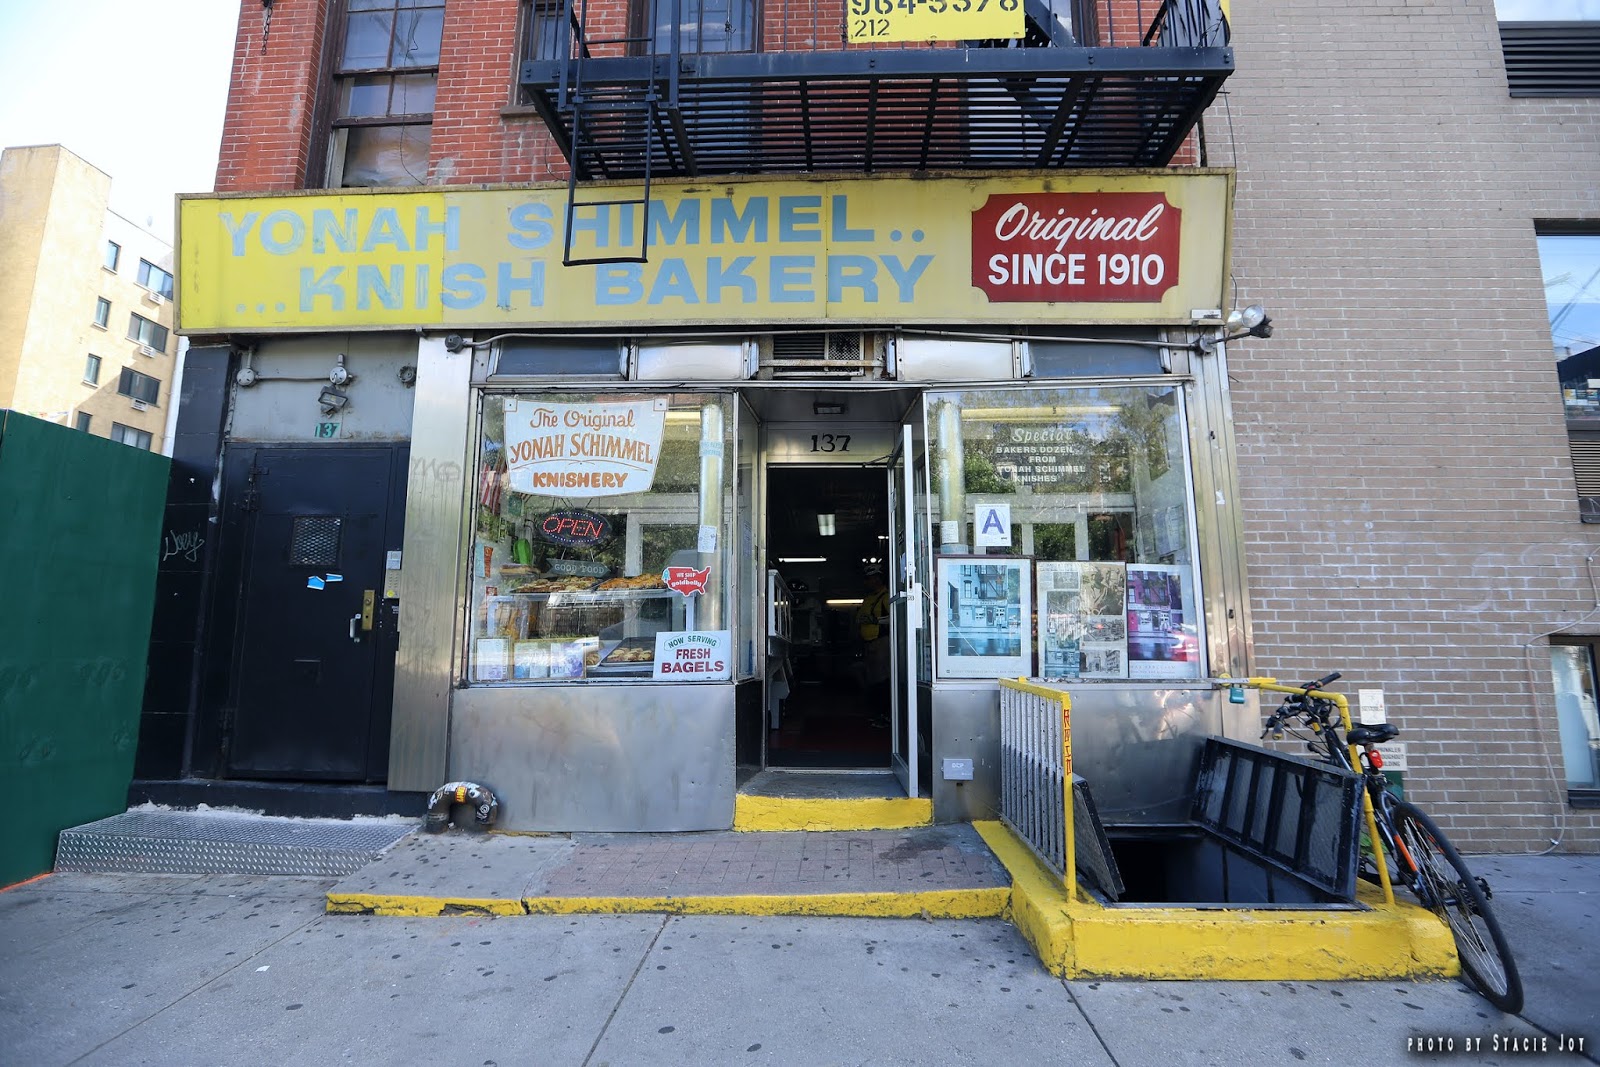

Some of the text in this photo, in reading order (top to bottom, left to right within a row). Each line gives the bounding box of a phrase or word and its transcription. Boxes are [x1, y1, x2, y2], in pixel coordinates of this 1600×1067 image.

[854, 18, 890, 37] 212
[218, 205, 460, 256] YONAH
[994, 202, 1165, 253] Original
[988, 253, 1165, 286] SINCE 1910
[595, 254, 935, 307] BAKERY
[530, 407, 635, 431] The Original
[314, 422, 341, 438] 137
[1012, 427, 1073, 443] Special
[509, 432, 653, 464] YONAH SCHIMMEL
[810, 433, 851, 453] 137
[996, 446, 1073, 454] BAKERS DOZEN
[1035, 465, 1086, 473] SCHIMMEL
[533, 472, 628, 488] KNISHERY
[542, 516, 604, 539] OPEN
[981, 509, 1005, 534] A
[668, 635, 717, 648] NOW SERVING
[676, 648, 711, 660] FRESH
[661, 660, 724, 674] BAGELS
